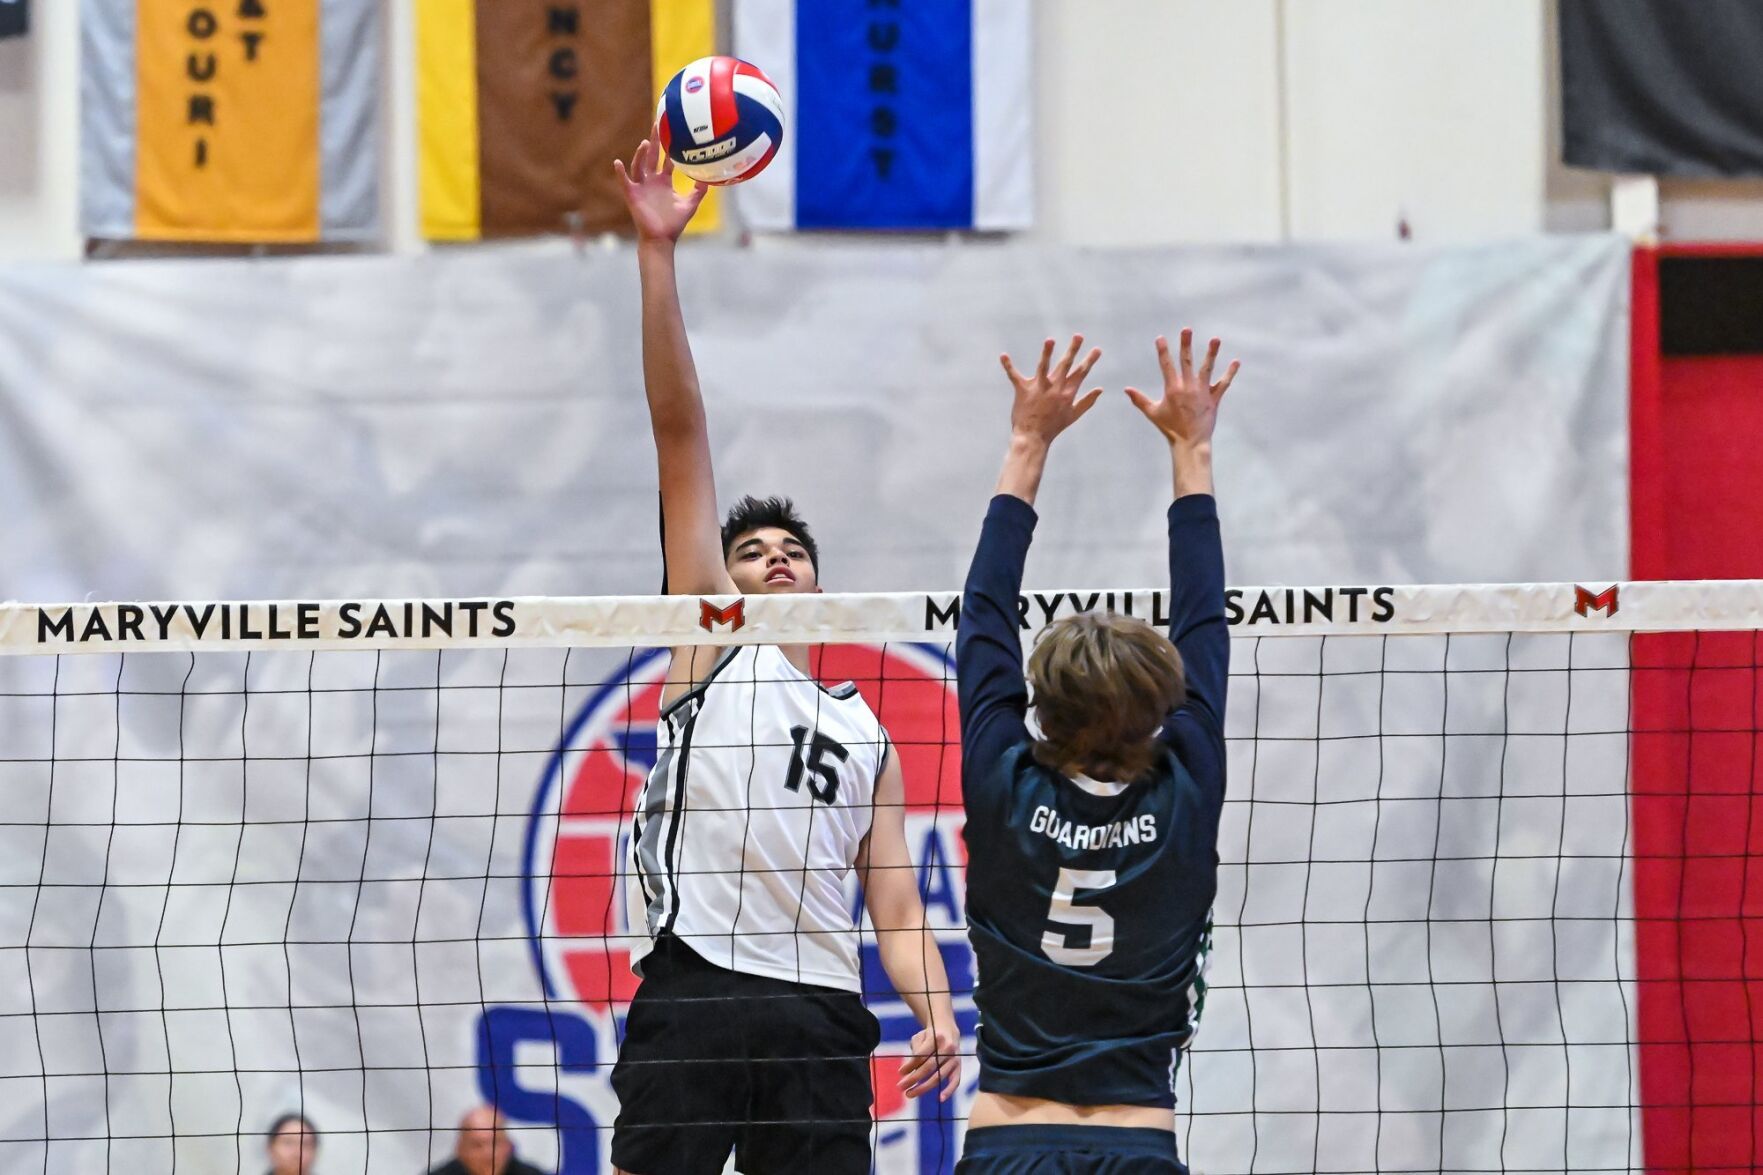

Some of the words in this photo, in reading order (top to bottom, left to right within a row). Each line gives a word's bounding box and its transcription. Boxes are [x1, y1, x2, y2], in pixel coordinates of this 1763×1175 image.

[38, 603, 320, 643] MARYVILLE
[337, 601, 516, 638] SAINTS
[1225, 586, 1395, 626] SAINTS
[784, 724, 850, 806] 15
[1030, 805, 1158, 851] GUARDIANS
[1041, 867, 1117, 966] 5
